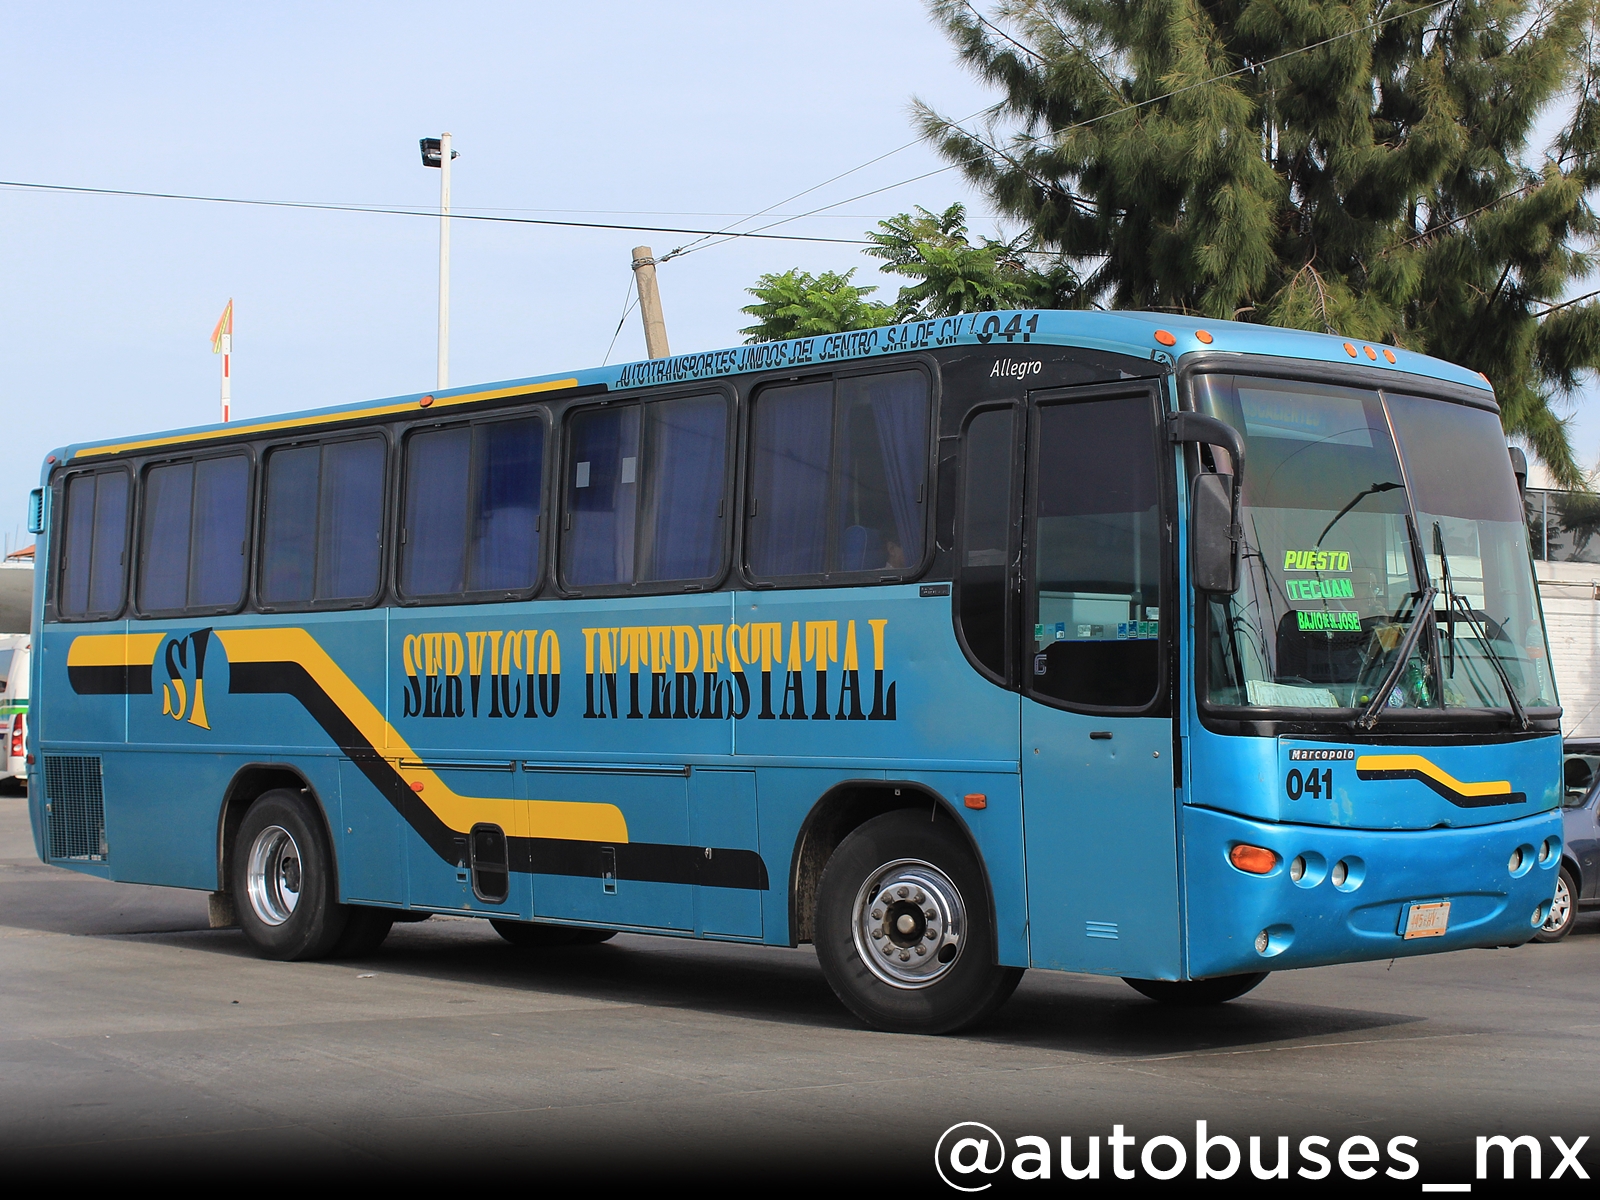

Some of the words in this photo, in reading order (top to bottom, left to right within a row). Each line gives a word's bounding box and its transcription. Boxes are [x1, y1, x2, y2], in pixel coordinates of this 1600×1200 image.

[976, 313, 1039, 345] 041
[615, 350, 737, 388] AUTOTRANSPORTES
[737, 343, 788, 371] UNIDOS
[788, 339, 814, 365] DEL
[819, 330, 878, 361] CENTRO
[911, 322, 936, 348] DE
[989, 358, 1042, 380] Allegro
[1284, 550, 1349, 571] PUESTO
[1287, 579, 1354, 599] TECUAN
[1297, 611, 1324, 630] BAJIO
[1337, 612, 1361, 630] JOSE
[162, 627, 213, 731] SI
[403, 629, 561, 719] SERVICIO
[581, 619, 898, 721] INTERESTATAL
[1291, 749, 1354, 760] Marcopolo
[1286, 768, 1332, 801] 041
